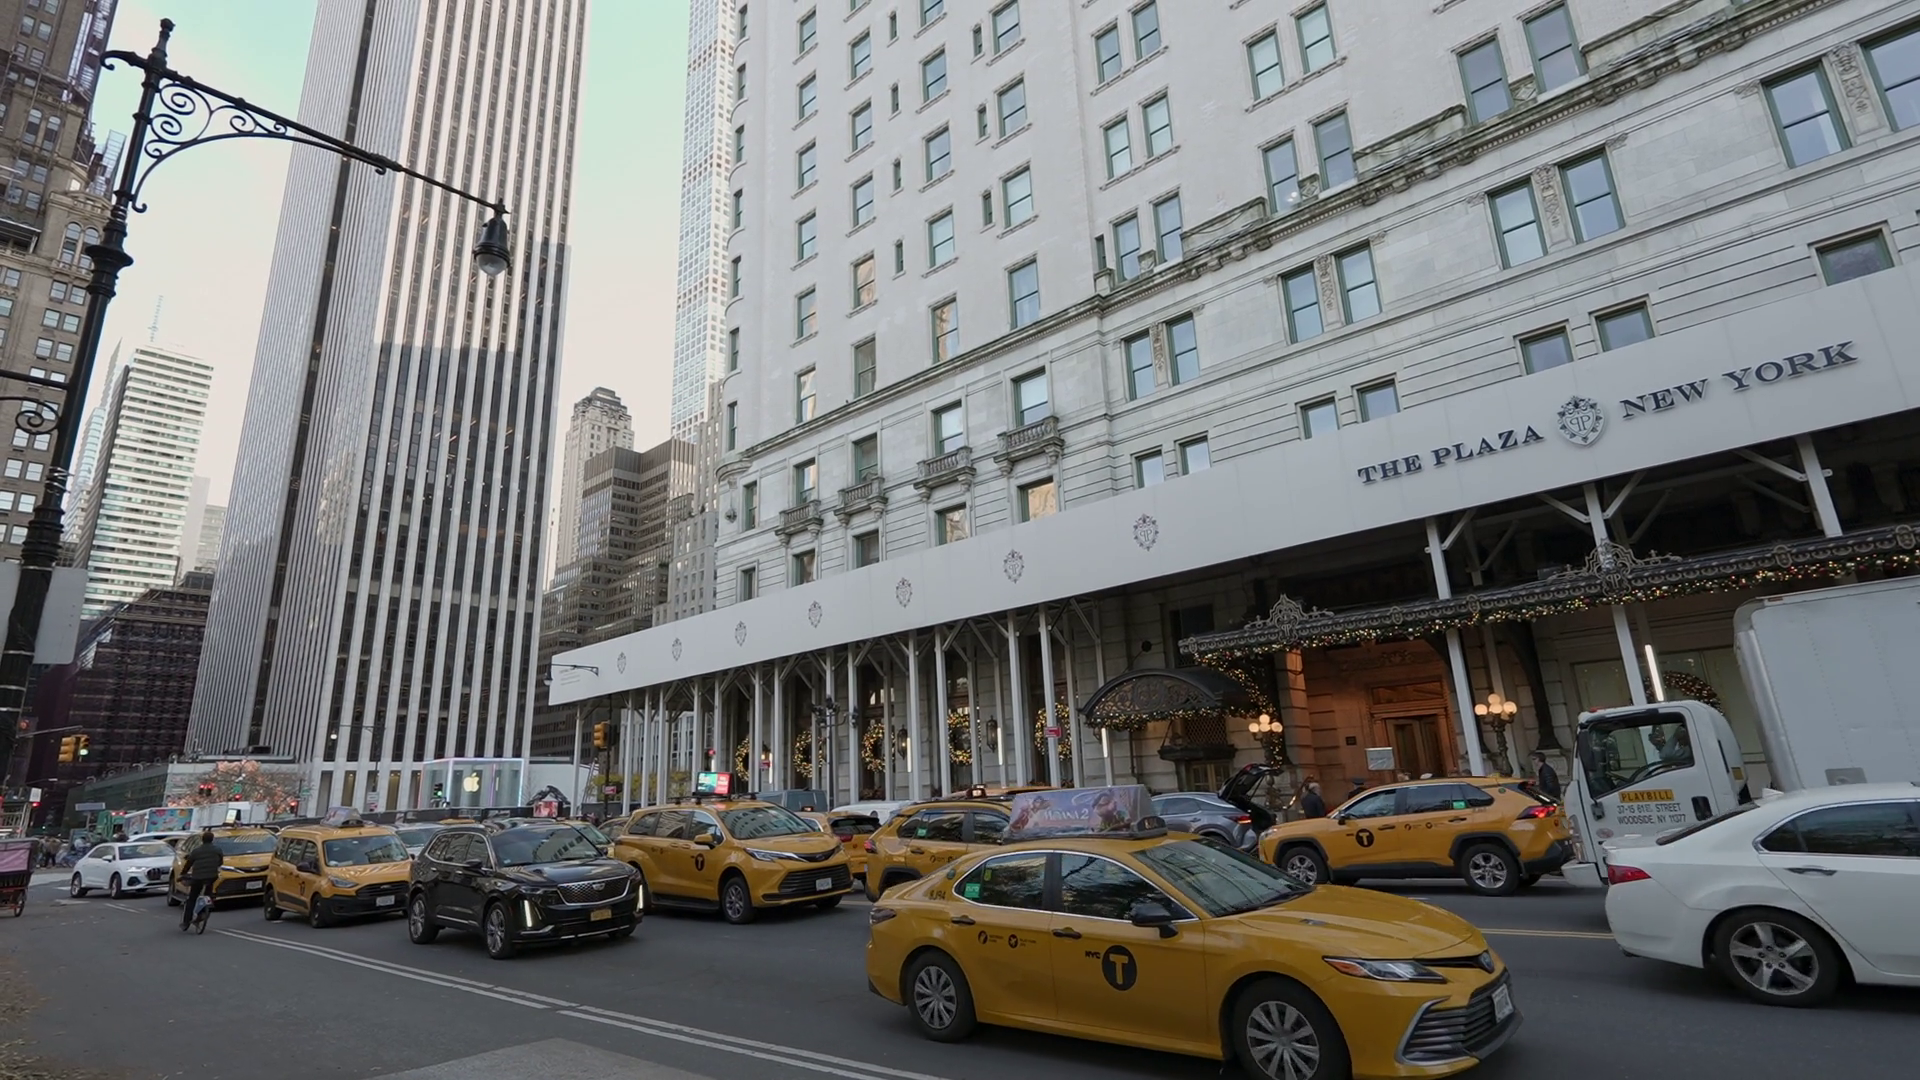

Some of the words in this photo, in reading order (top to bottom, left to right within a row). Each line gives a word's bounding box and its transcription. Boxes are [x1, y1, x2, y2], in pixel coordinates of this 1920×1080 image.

[1357, 454, 1422, 484] THE
[1431, 425, 1544, 466] PLAZA
[1619, 379, 1708, 418] NEW
[1722, 341, 1857, 390] YORK
[1622, 791, 1672, 802] PLAYBILL
[1655, 803, 1681, 812] STREET
[1657, 815, 1667, 823] NY
[1085, 950, 1101, 960] NYC
[1109, 953, 1129, 985] T
